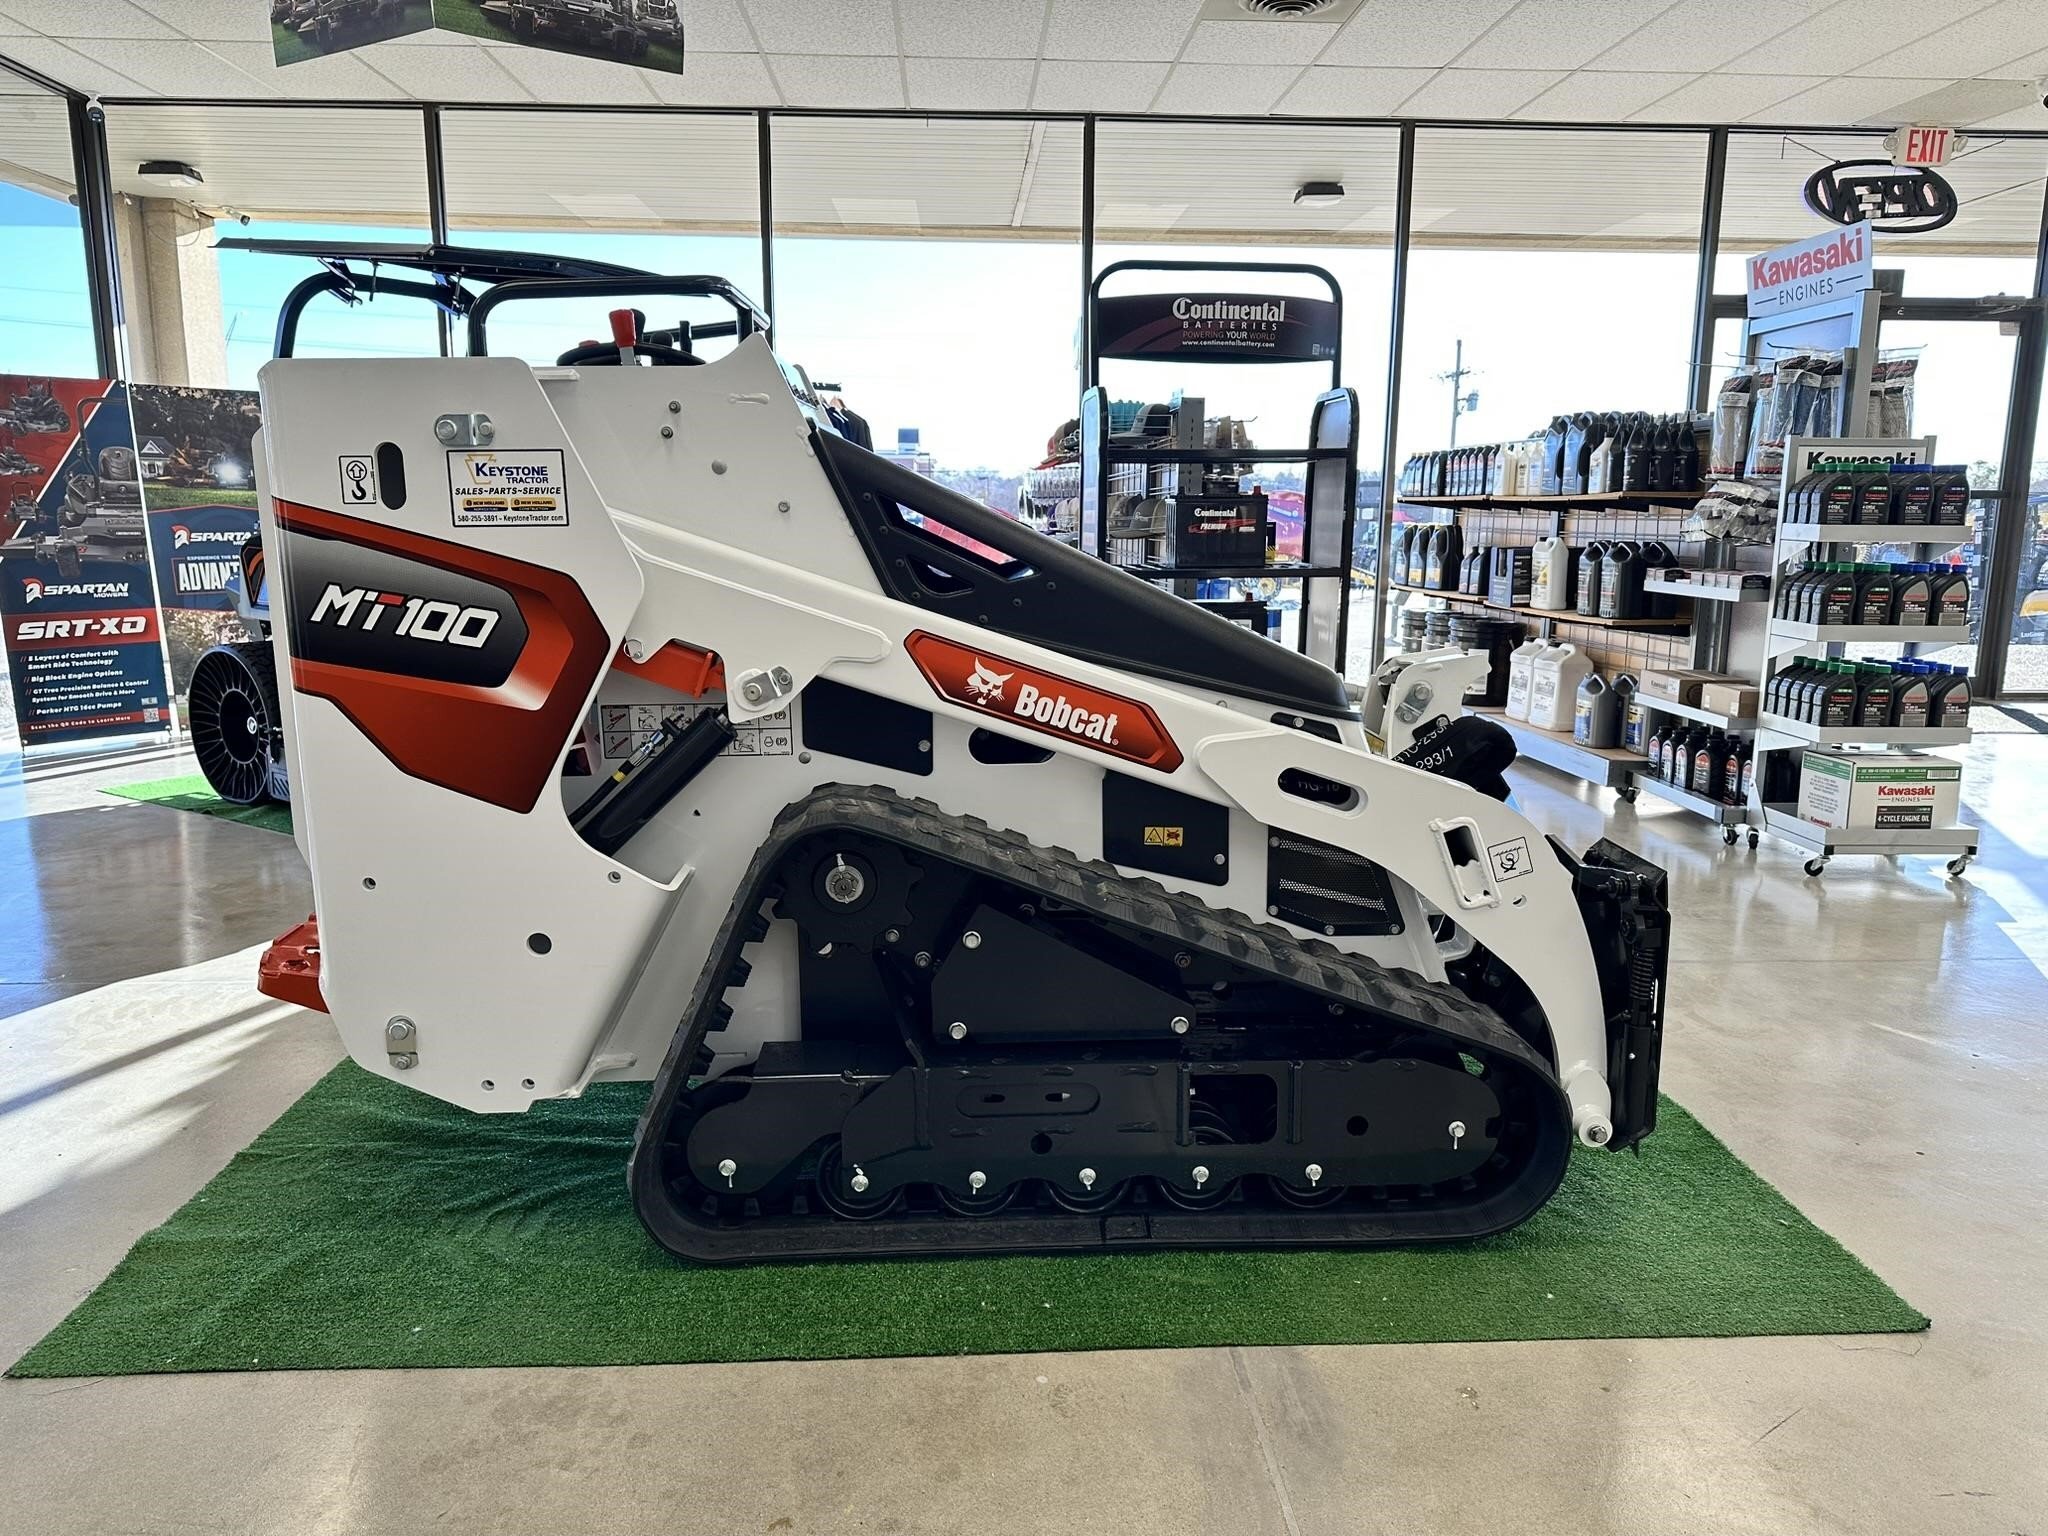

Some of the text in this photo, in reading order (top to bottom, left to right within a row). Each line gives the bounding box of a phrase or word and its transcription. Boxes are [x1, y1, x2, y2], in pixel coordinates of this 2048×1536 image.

[1906, 129, 1948, 162] EXIT
[1752, 227, 1862, 290] Kawasaki
[1779, 278, 1834, 306] ENGINES
[1172, 297, 1286, 322] Continental
[1183, 321, 1278, 332] BATTERIES
[1183, 331, 1276, 341] POWERING YOUR WORLD
[1182, 340, 1275, 349] www.continentalbattery.com
[1194, 508, 1236, 518] Continental
[190, 532, 252, 542] SPARTA
[179, 562, 240, 591] ADVANT
[44, 583, 129, 596] SPARTAN
[17, 616, 147, 640] SRT-XD
[34, 654, 60, 663] Layers
[71, 651, 101, 659] Comfort
[71, 659, 114, 667] Technology
[31, 676, 44, 684] Big
[68, 672, 94, 681] Engine
[94, 669, 124, 678] Options
[60, 684, 91, 692] Precision
[1014, 684, 1118, 744] Bobcat
[1878, 786, 1936, 796] Kawasaki
